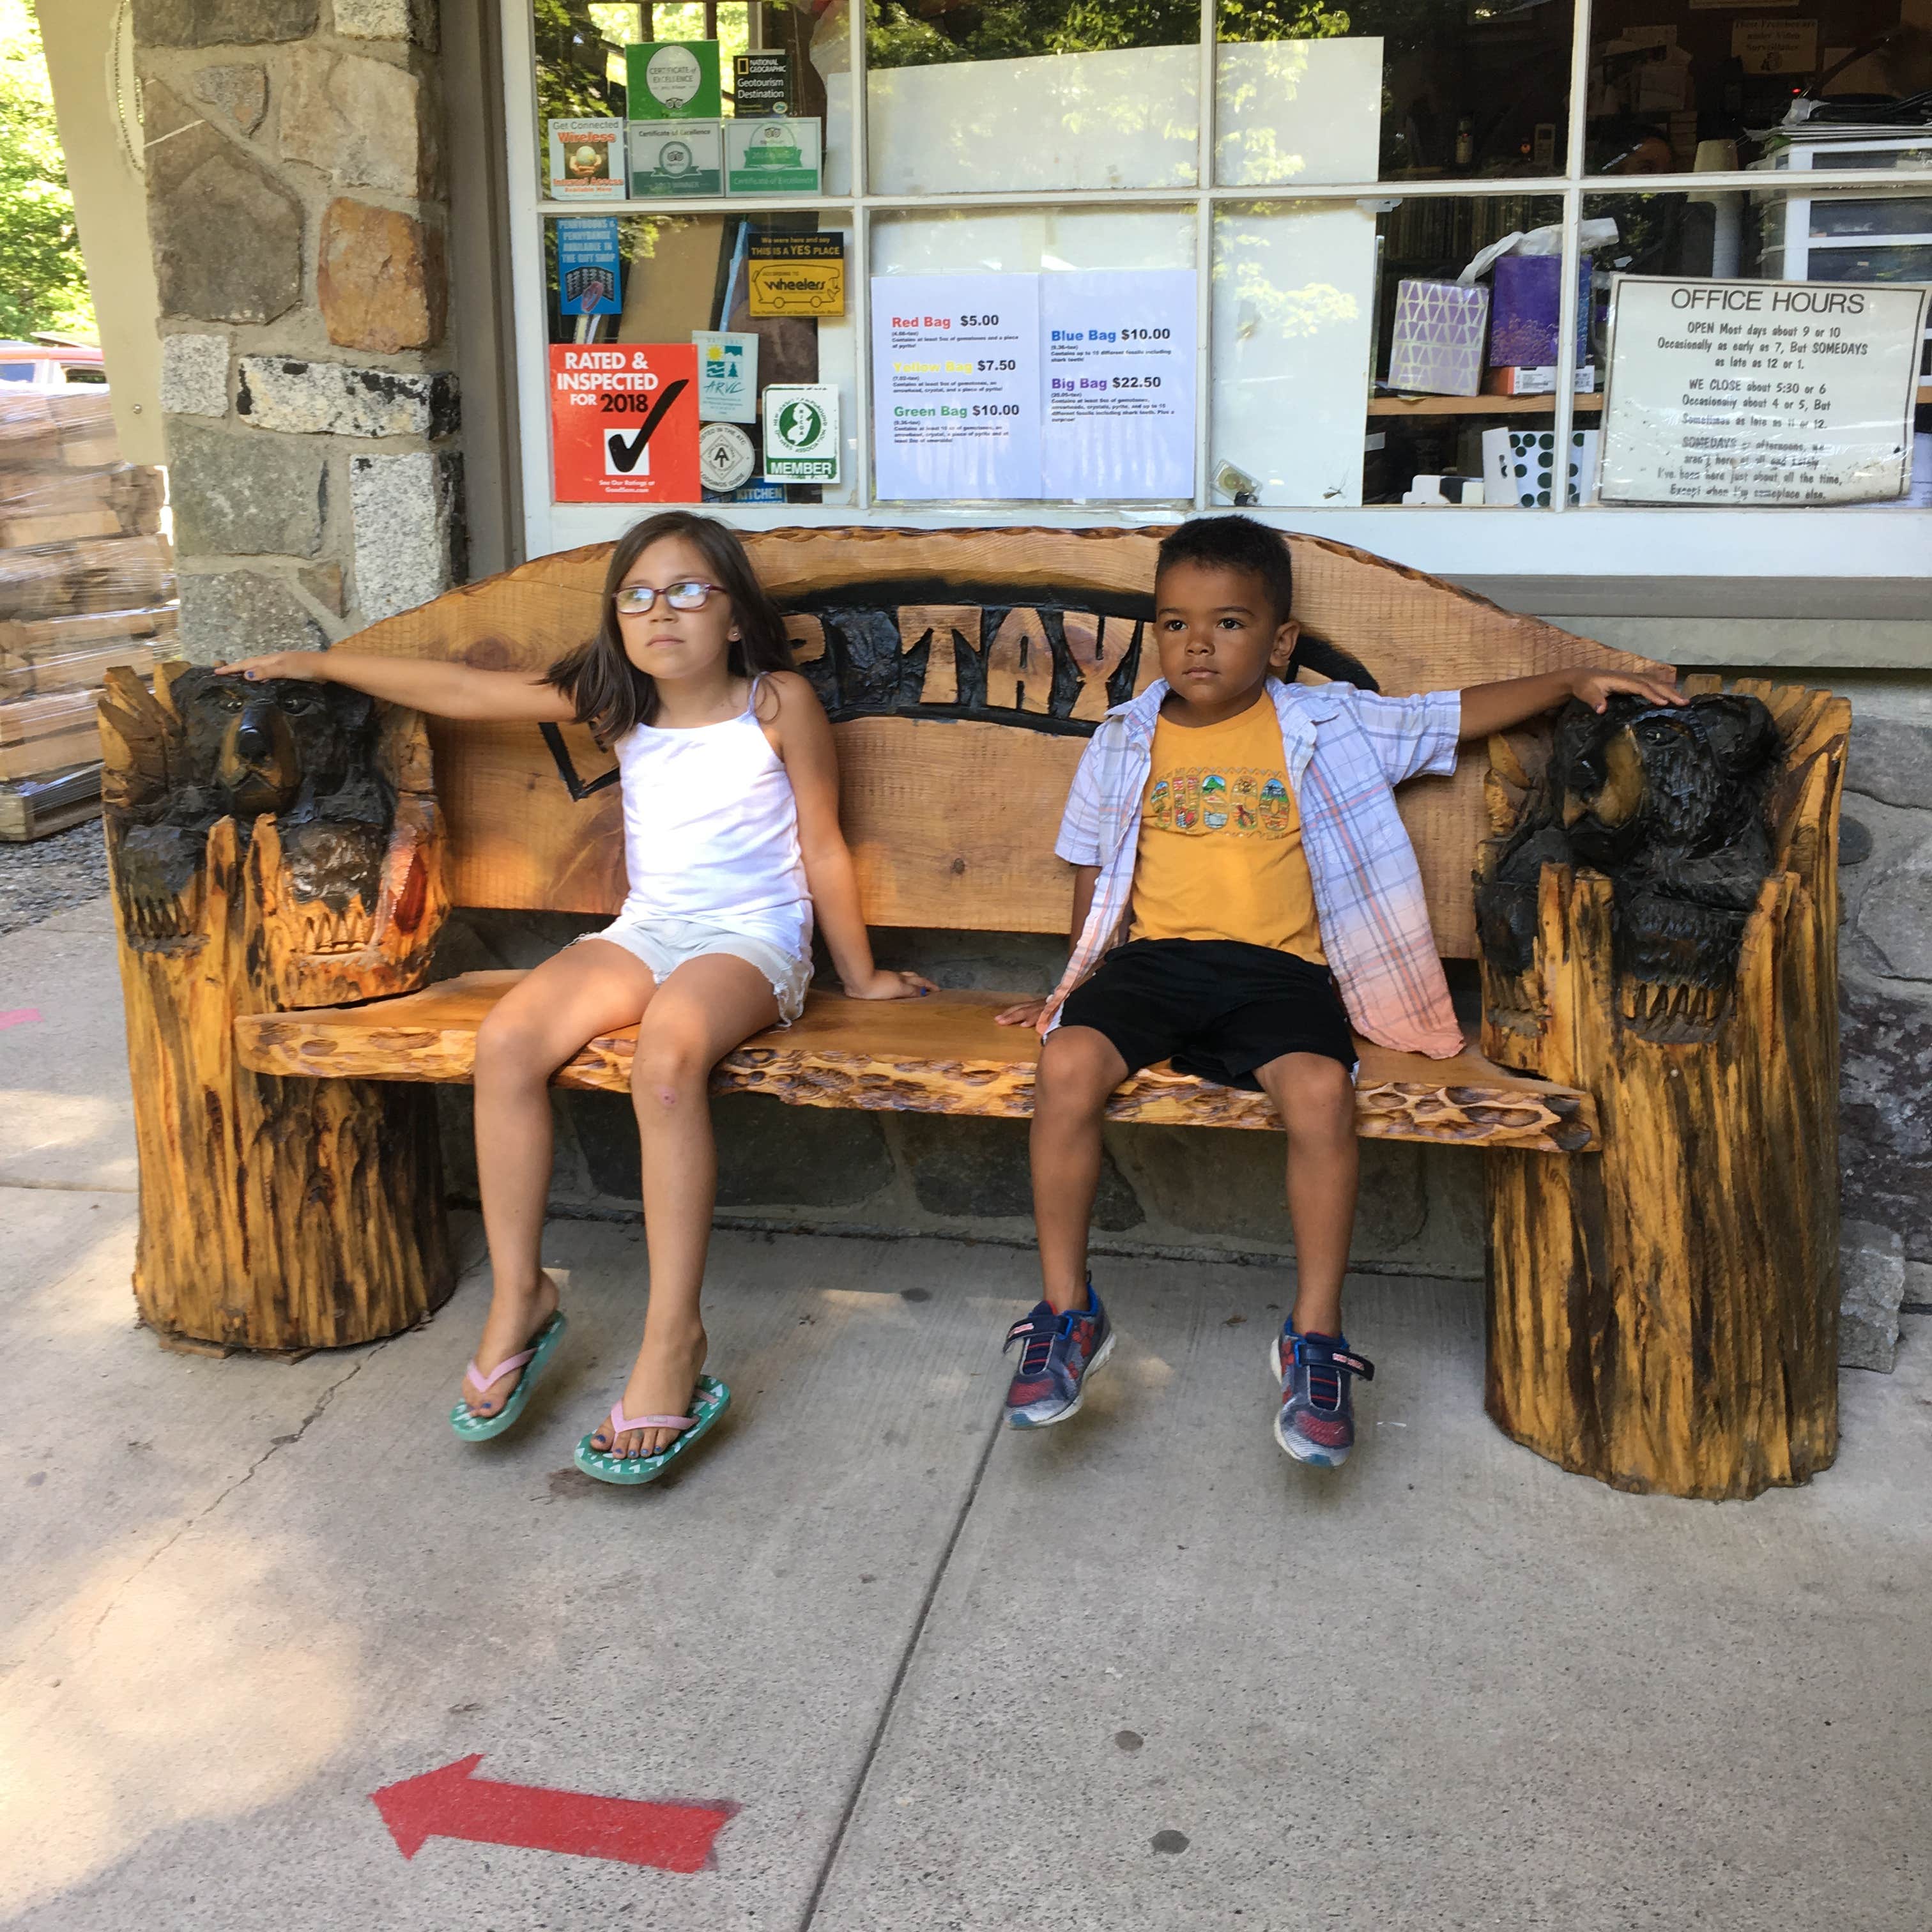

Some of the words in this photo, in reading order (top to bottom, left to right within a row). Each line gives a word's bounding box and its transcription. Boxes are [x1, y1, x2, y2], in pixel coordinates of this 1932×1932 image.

[737, 79, 783, 87] Geotourism
[737, 89, 784, 98] Destination
[553, 121, 568, 130] Get
[571, 121, 619, 129] Connected
[558, 132, 617, 143] Wireless
[639, 129, 670, 137] Certificate
[751, 247, 771, 256] THIS
[790, 245, 811, 255] YES
[764, 278, 826, 290] wheelers
[1671, 288, 1763, 310] OFFICE
[1772, 291, 1865, 314] HOURS
[892, 317, 919, 327] Red
[924, 316, 951, 329] Bag
[960, 315, 999, 326] $5.00
[1051, 330, 1084, 341] Blue
[1089, 330, 1116, 342] Bag
[1121, 328, 1170, 341] $10.00
[1687, 321, 1715, 334] OPEN
[1720, 323, 1742, 335] Most
[1747, 324, 1767, 339] days
[1772, 325, 1798, 337] about
[1803, 326, 1810, 337] 9
[1815, 328, 1825, 337] or
[1829, 327, 1841, 338] 10
[1658, 337, 1712, 353] Occasionally
[1717, 342, 1727, 351] as
[1733, 340, 1754, 354] early
[1759, 344, 1769, 352] as
[1775, 342, 1784, 354] 7,
[1790, 341, 1807, 353] But
[1812, 342, 1868, 355] SOMEDAYS
[565, 352, 626, 370] RATED
[632, 351, 649, 370] &
[893, 362, 940, 372] Yellow
[945, 361, 972, 374] Bag
[977, 360, 1016, 371] $7.50
[1715, 358, 1724, 367] as
[1730, 356, 1747, 367] late
[1752, 359, 1761, 368] as
[1767, 358, 1778, 369] 12
[1783, 360, 1793, 369] or
[1797, 358, 1804, 369] 1.
[556, 372, 659, 390] INSPECTED
[703, 380, 746, 395] ARVC
[1052, 378, 1075, 391] Big
[1080, 378, 1107, 391] Bag
[1112, 377, 1161, 388] $22.50
[1689, 378, 1704, 390] WE
[1710, 378, 1741, 391] CLOSE
[1747, 381, 1771, 392] about
[1776, 382, 1800, 394] 5:30
[1819, 383, 1826, 394] 6
[570, 394, 597, 406] FOR
[601, 394, 648, 413] 2018
[1682, 394, 1738, 409] Occasionally
[1743, 396, 1767, 408] about
[1772, 398, 1779, 409] 4
[1784, 401, 1794, 409] or
[1799, 399, 1808, 412] 5,
[1814, 399, 1831, 410] But
[894, 406, 935, 417] Green
[940, 406, 967, 418] Bag
[972, 404, 1020, 416] $10.00
[1682, 413, 1730, 425] Sometimes
[1735, 417, 1745, 425] as
[1751, 415, 1767, 427] late
[1772, 419, 1782, 427] as
[1814, 419, 1827, 429] 12.
[1682, 436, 1736, 448] SOMEDAYS
[770, 461, 832, 475] MEMBER
[1657, 467, 1675, 479] I've
[1705, 469, 1724, 480] here
[1730, 470, 1749, 484] just
[1753, 470, 1777, 483] about
[1784, 471, 1794, 482] all
[1800, 471, 1814, 484] the
[1819, 473, 1843, 486] time,
[736, 487, 783, 500] KITCHEN
[1670, 483, 1701, 498] Except
[1754, 487, 1800, 501] someplace
[896, 604, 1155, 723] TAY
